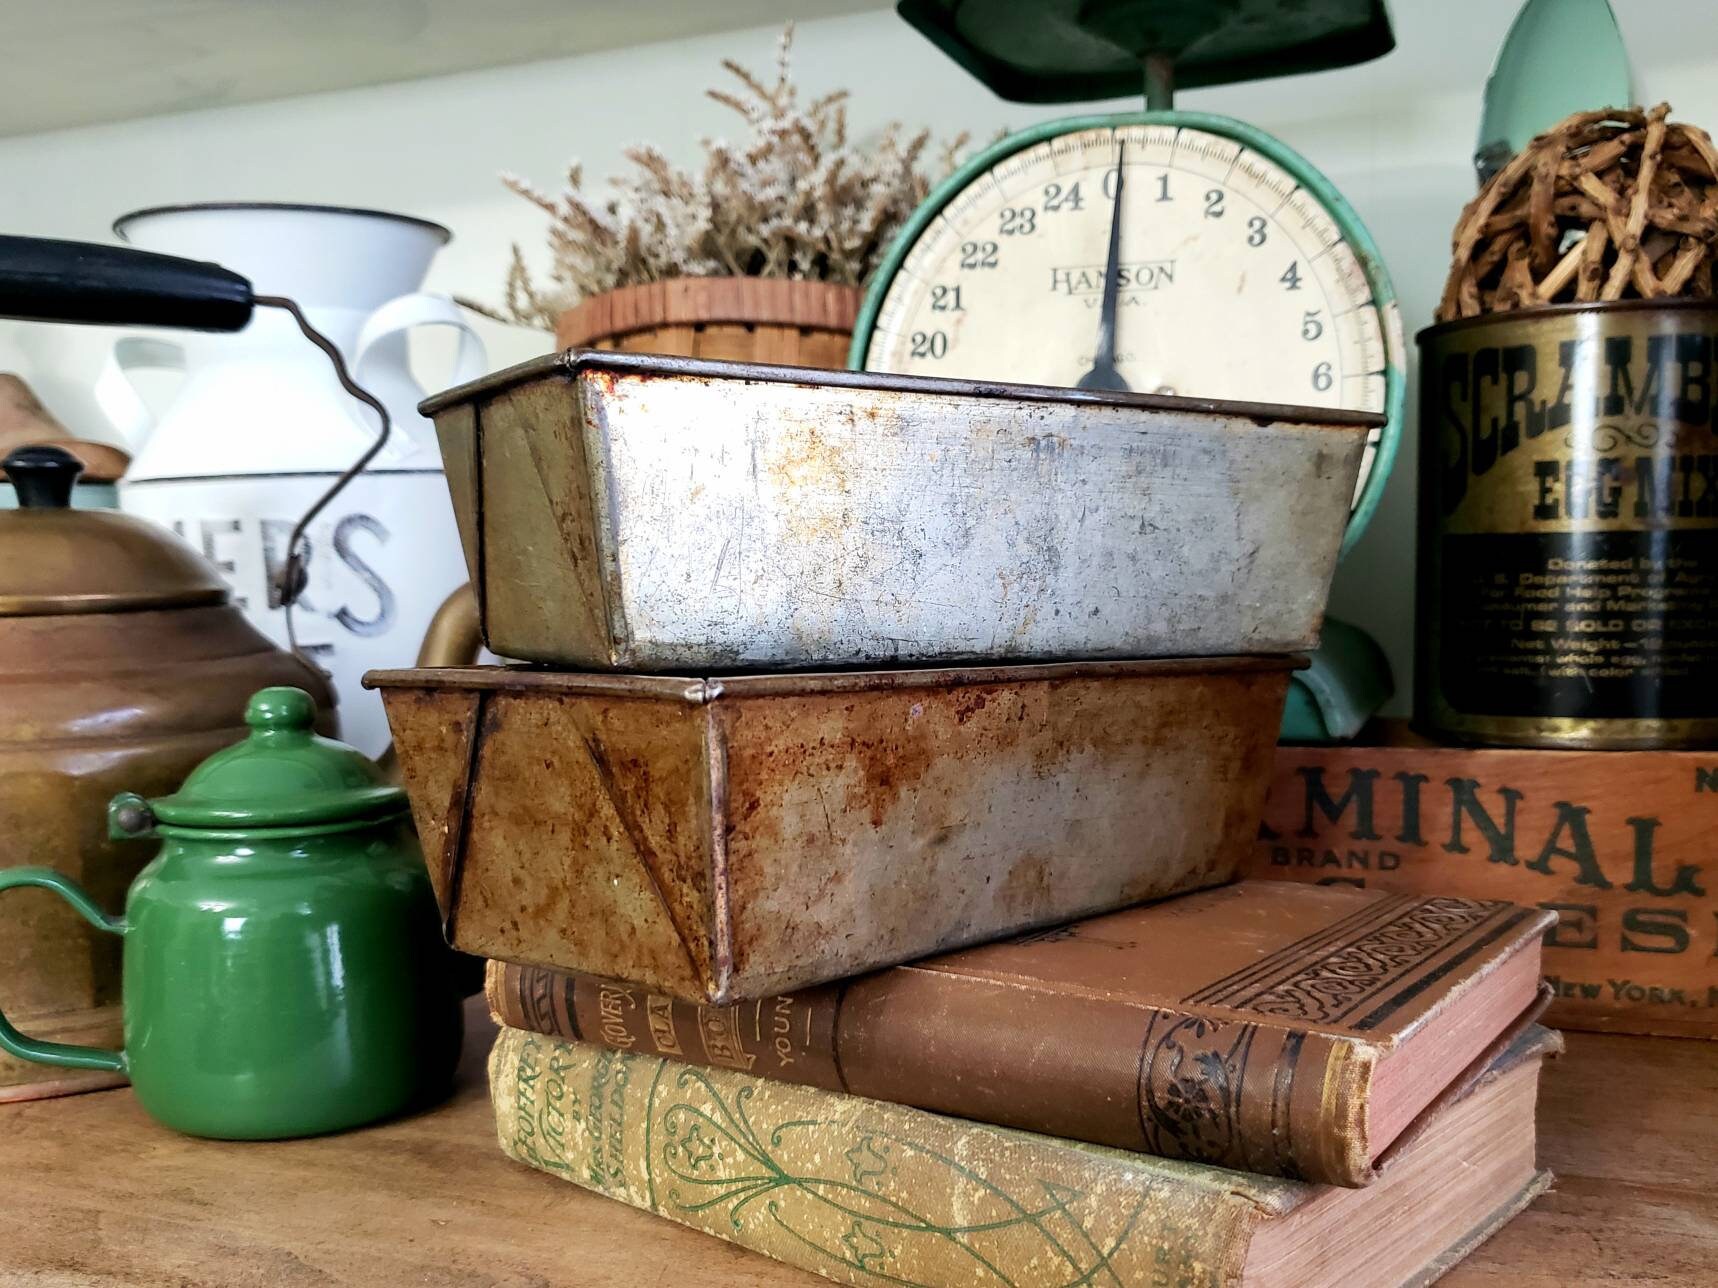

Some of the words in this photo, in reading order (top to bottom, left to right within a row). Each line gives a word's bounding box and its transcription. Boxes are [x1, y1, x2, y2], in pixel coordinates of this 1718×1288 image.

[1044, 182, 1084, 212] 24
[1155, 174, 1174, 202] 1
[1204, 190, 1226, 218] 2
[999, 208, 1036, 236] 23
[1247, 218, 1268, 247] 3
[960, 242, 999, 270] 22
[1051, 260, 1176, 295] HANSON
[1279, 262, 1302, 290] 4
[931, 285, 964, 312] 21
[1302, 311, 1323, 341] 5
[910, 332, 948, 359] 20
[1311, 363, 1333, 391] 6
[1440, 333, 1718, 516] SCRAMB
[1533, 458, 1623, 520] EGG
[172, 512, 396, 637] ERS
[1565, 619, 1624, 632] SOLD
[1258, 766, 1706, 897] MINAL
[1271, 846, 1399, 872] BRAND
[654, 1003, 677, 1048] CLA
[774, 996, 795, 1067] YOUN
